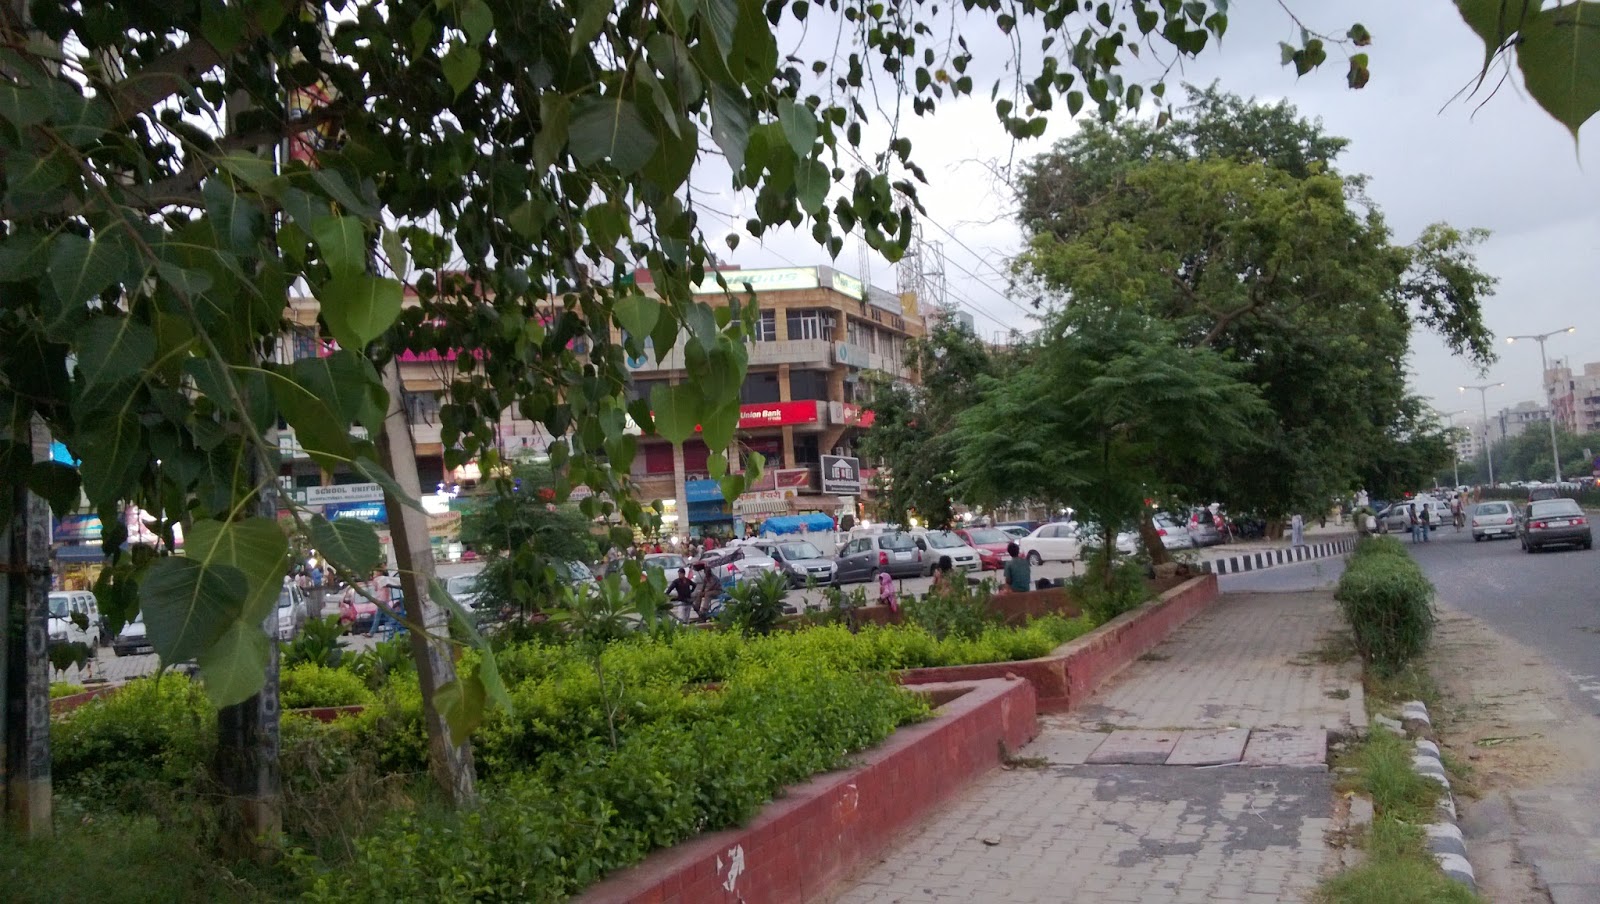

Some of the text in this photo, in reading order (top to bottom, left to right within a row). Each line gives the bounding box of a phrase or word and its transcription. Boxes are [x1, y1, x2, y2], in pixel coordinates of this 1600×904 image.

[740, 411, 761, 419] Union
[762, 409, 782, 418] Bank
[315, 487, 347, 495] SCHOOL
